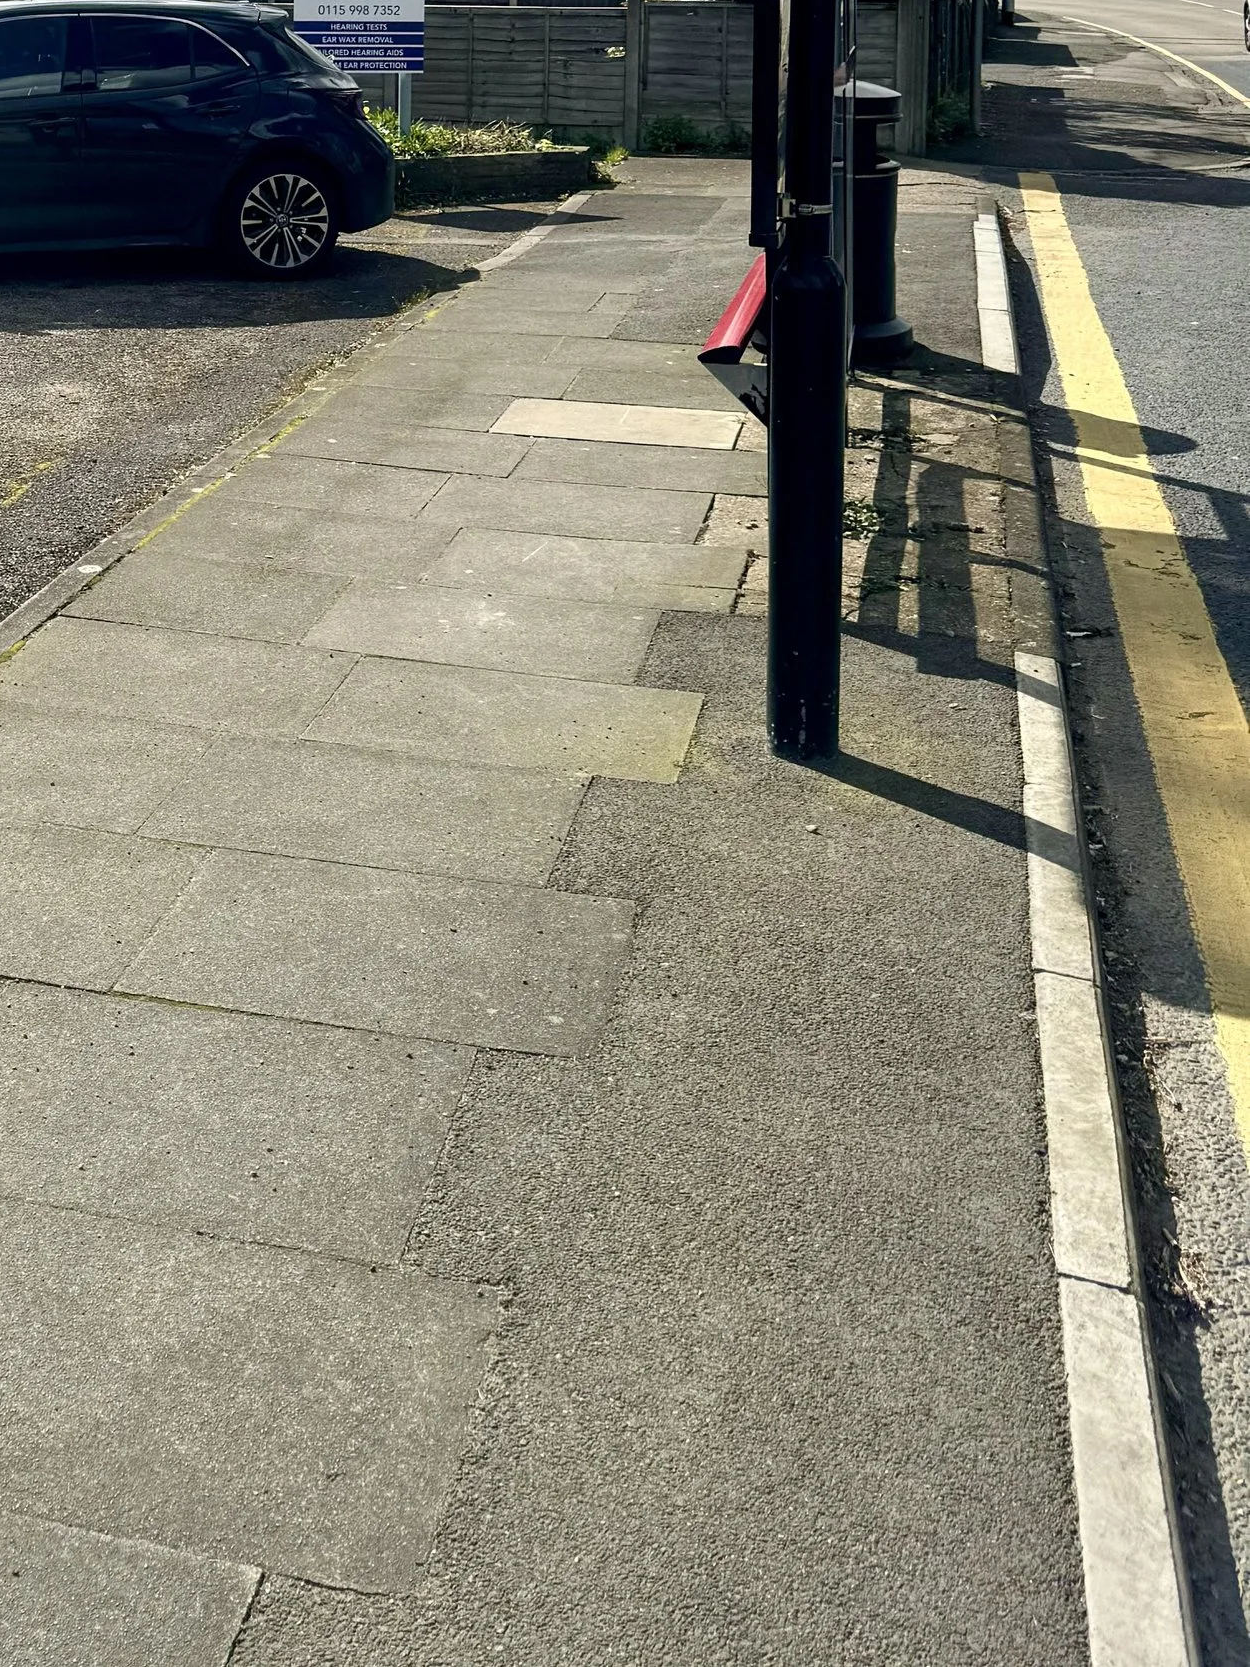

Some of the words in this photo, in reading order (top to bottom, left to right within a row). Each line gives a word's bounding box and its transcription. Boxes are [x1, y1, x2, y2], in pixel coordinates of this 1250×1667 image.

[318, 4, 346, 16] 0115
[348, 4, 370, 16] 998
[373, 5, 401, 16] 7352
[330, 23, 364, 31] HEARING
[366, 23, 388, 31] TESTS
[322, 36, 337, 44] EAR
[338, 36, 356, 44] WAX
[358, 36, 394, 44] REMOVAL
